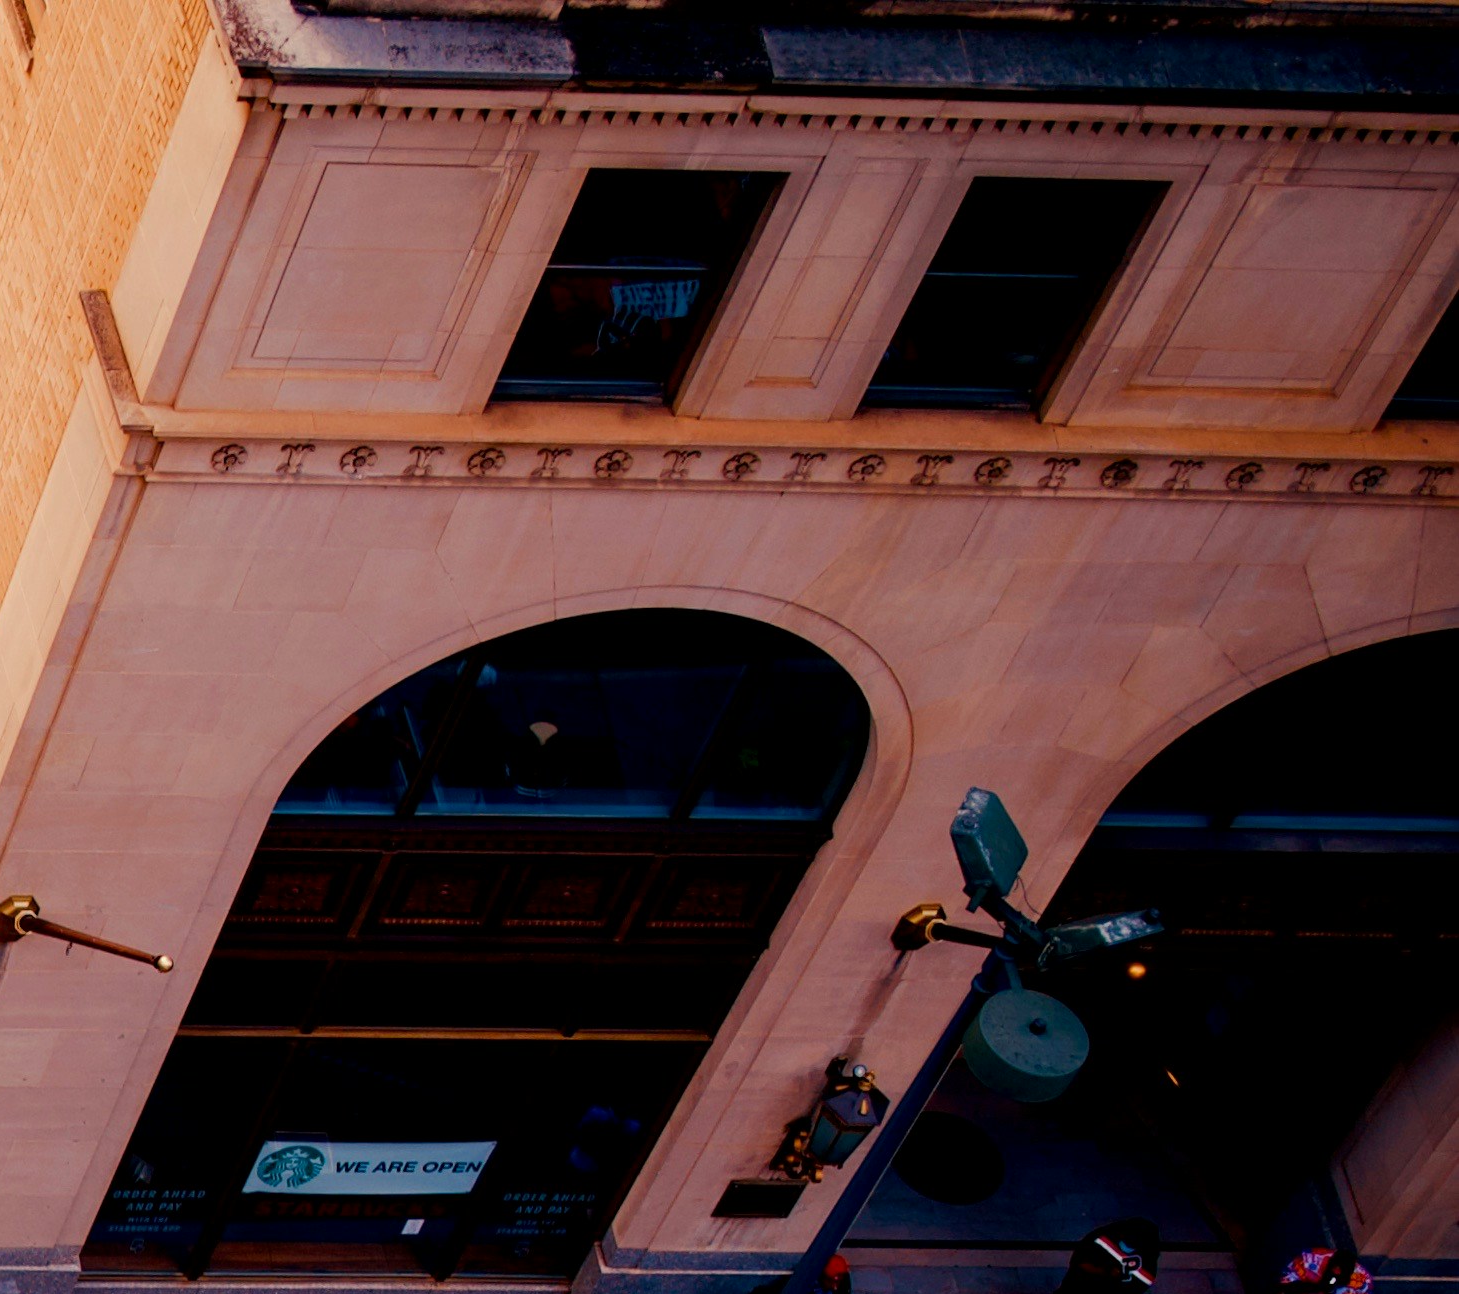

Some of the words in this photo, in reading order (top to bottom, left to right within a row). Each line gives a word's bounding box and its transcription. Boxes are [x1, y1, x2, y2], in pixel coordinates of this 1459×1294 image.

[336, 1162, 366, 1173] WE
[372, 1161, 417, 1173] ARE
[422, 1161, 483, 1174] OPEN
[112, 1189, 157, 1199] ORDER
[162, 1189, 206, 1199] AHEAD
[125, 1202, 153, 1212] AND
[159, 1202, 182, 1212] PAY
[253, 1201, 447, 1218] STARBUCKS
[514, 1205, 543, 1214] AND
[547, 1206, 571, 1214] PAY
